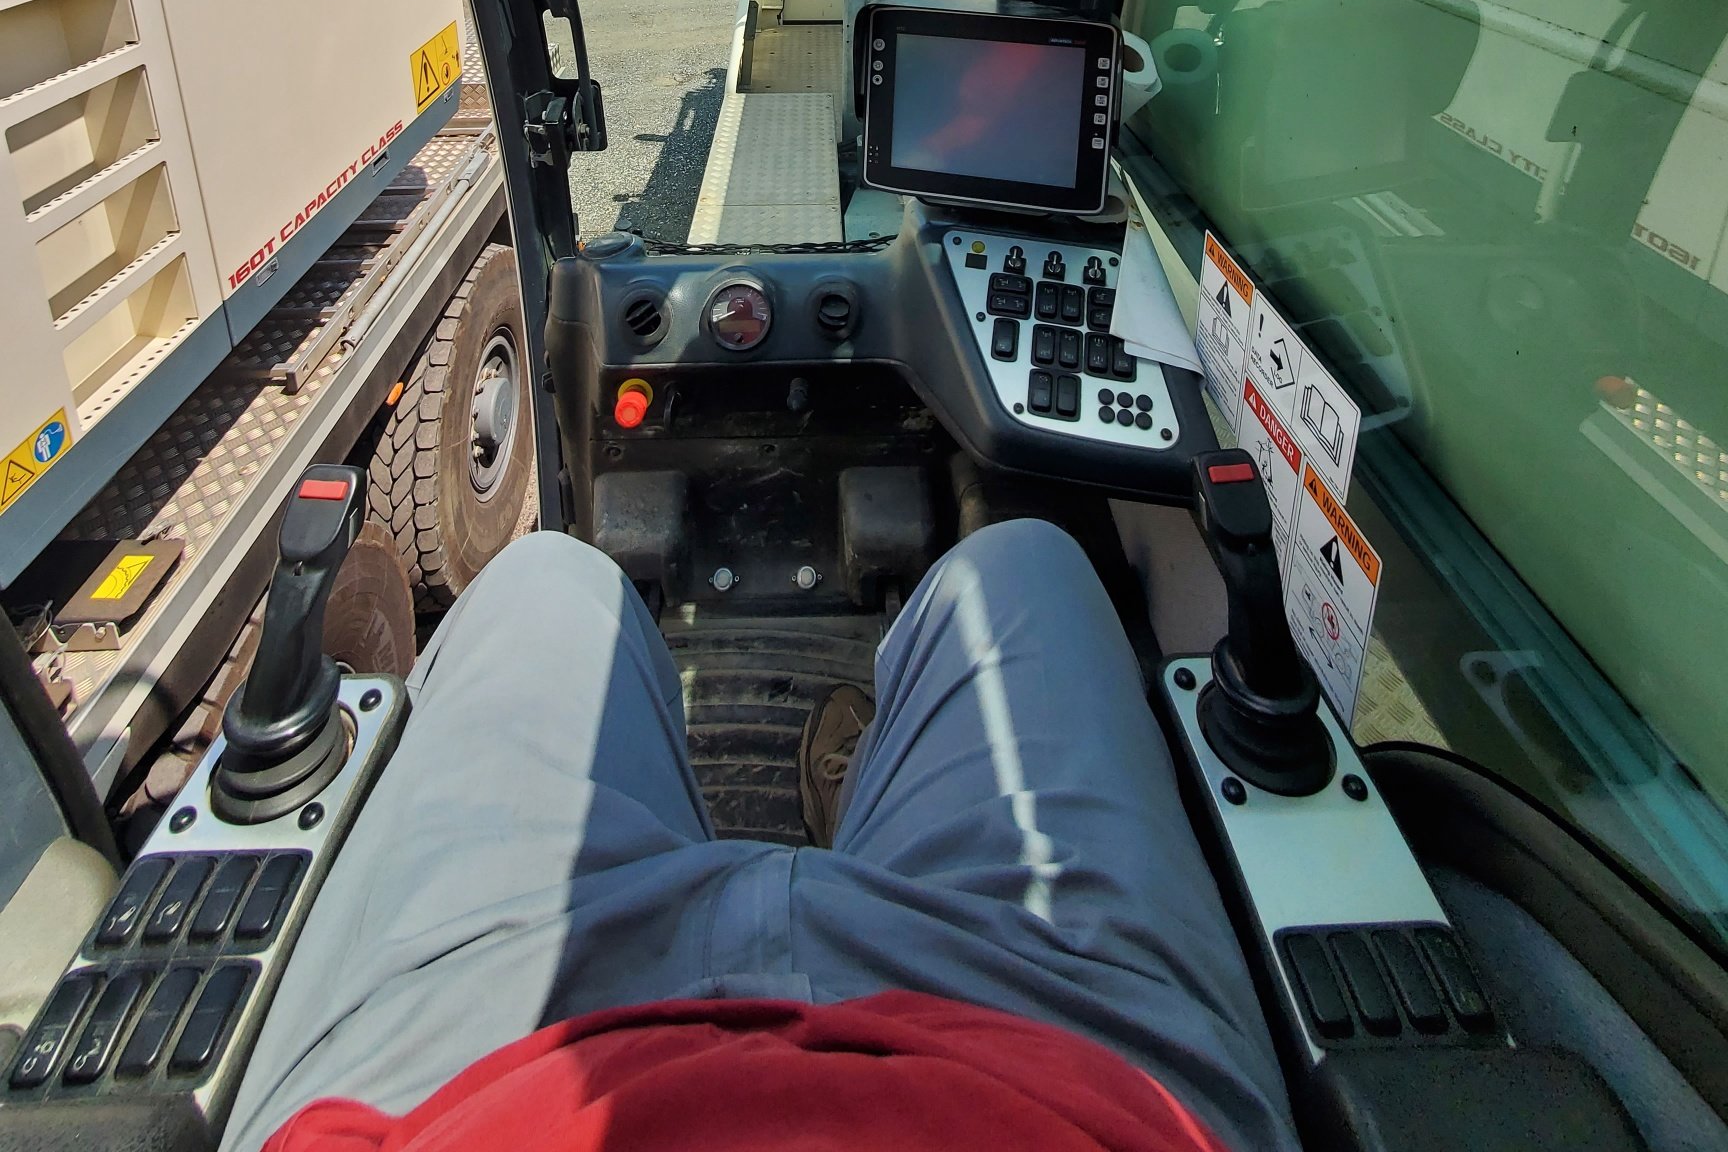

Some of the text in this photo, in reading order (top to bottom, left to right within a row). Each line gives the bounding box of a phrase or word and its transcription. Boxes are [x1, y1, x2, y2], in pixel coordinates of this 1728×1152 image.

[228, 120, 403, 290] 160T CAPACITY CLASS
[1217, 251, 1249, 298] WARNING
[1260, 404, 1294, 462] DANGER
[1322, 493, 1371, 571] WARNING
